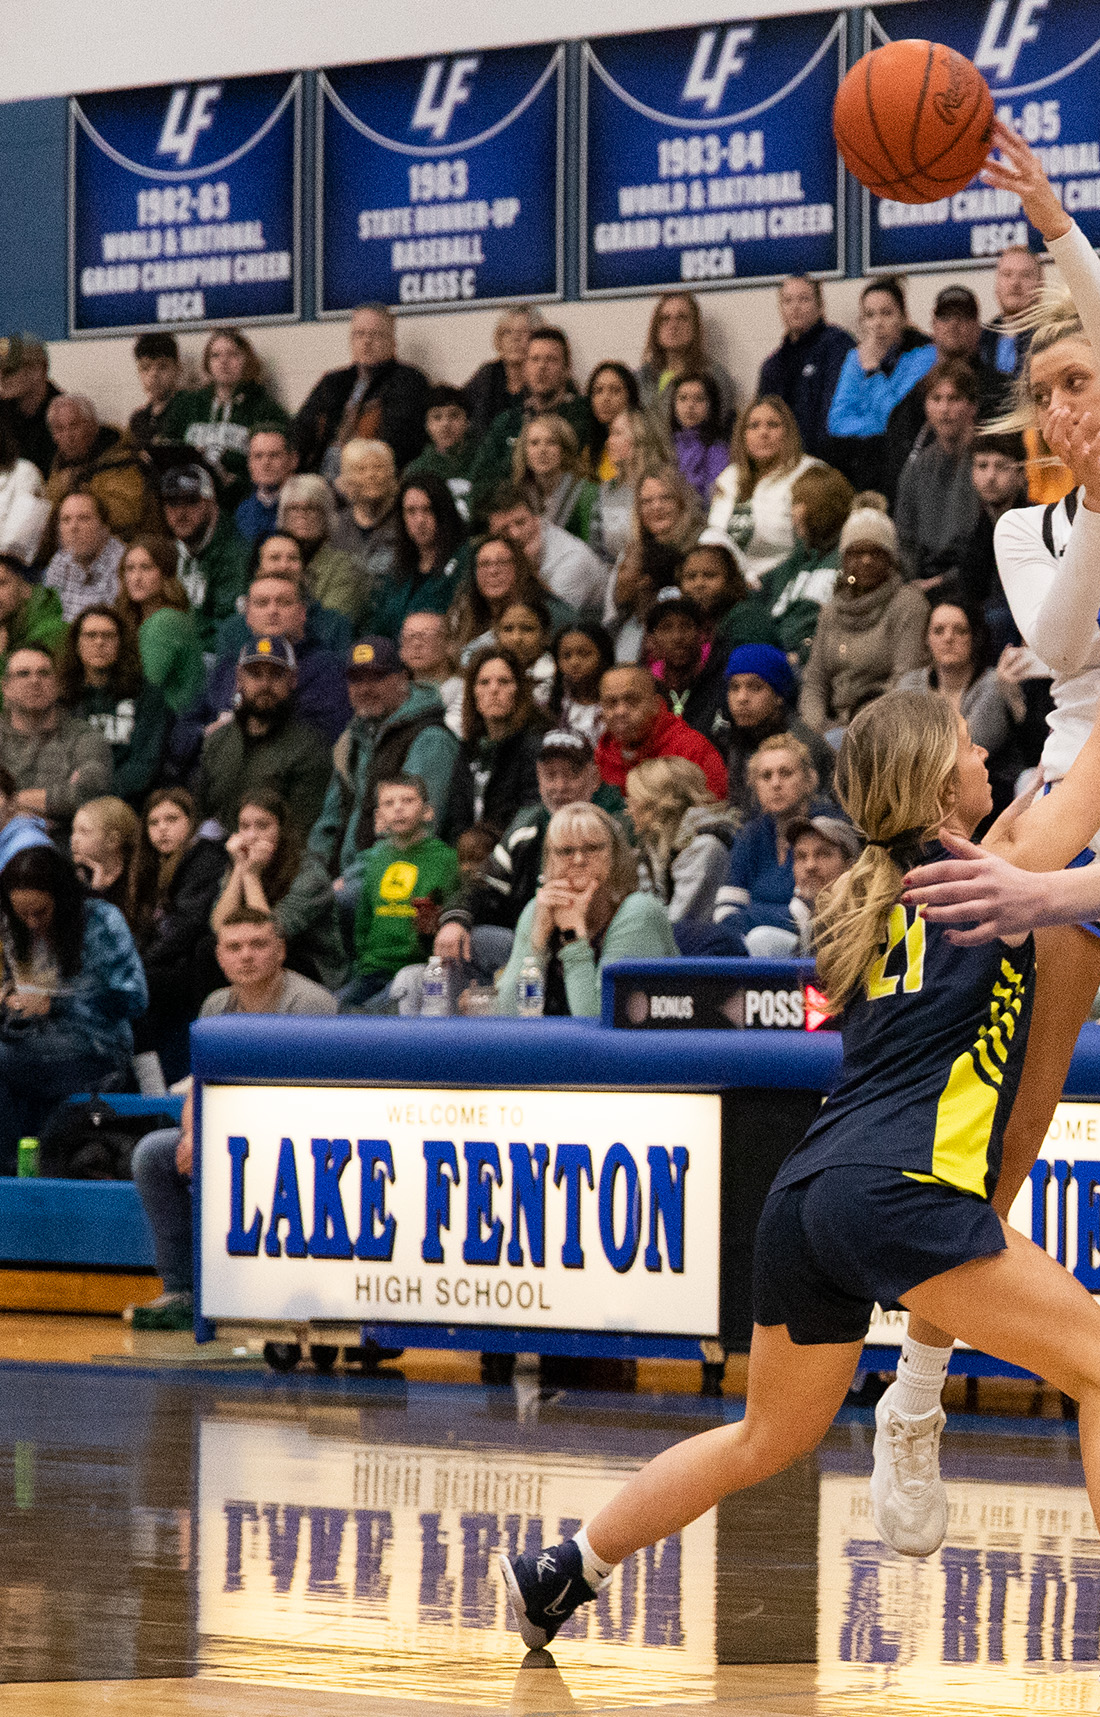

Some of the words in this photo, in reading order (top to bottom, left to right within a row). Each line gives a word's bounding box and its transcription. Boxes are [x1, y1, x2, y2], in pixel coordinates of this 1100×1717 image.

[619, 183, 687, 215] WORLD
[708, 172, 804, 206] NATIONAL
[358, 208, 411, 239] STATE
[595, 220, 660, 252] GRAND
[663, 211, 766, 245] CHAMPION
[769, 205, 833, 236] CHEER
[392, 236, 484, 269] BASEBALL
[400, 272, 459, 299] CLASS
[462, 270, 475, 296] C
[866, 903, 928, 1001] 21
[650, 995, 694, 1019] BONUS
[745, 989, 804, 1027] POSS
[386, 1103, 488, 1126] WELCOME
[498, 1105, 524, 1127] TO
[1048, 1119, 1098, 1141] OME
[225, 1136, 397, 1262] LAKE
[421, 1140, 690, 1274] FENTON
[355, 1275, 422, 1304] HIGH
[436, 1277, 551, 1310] SCHOOL
